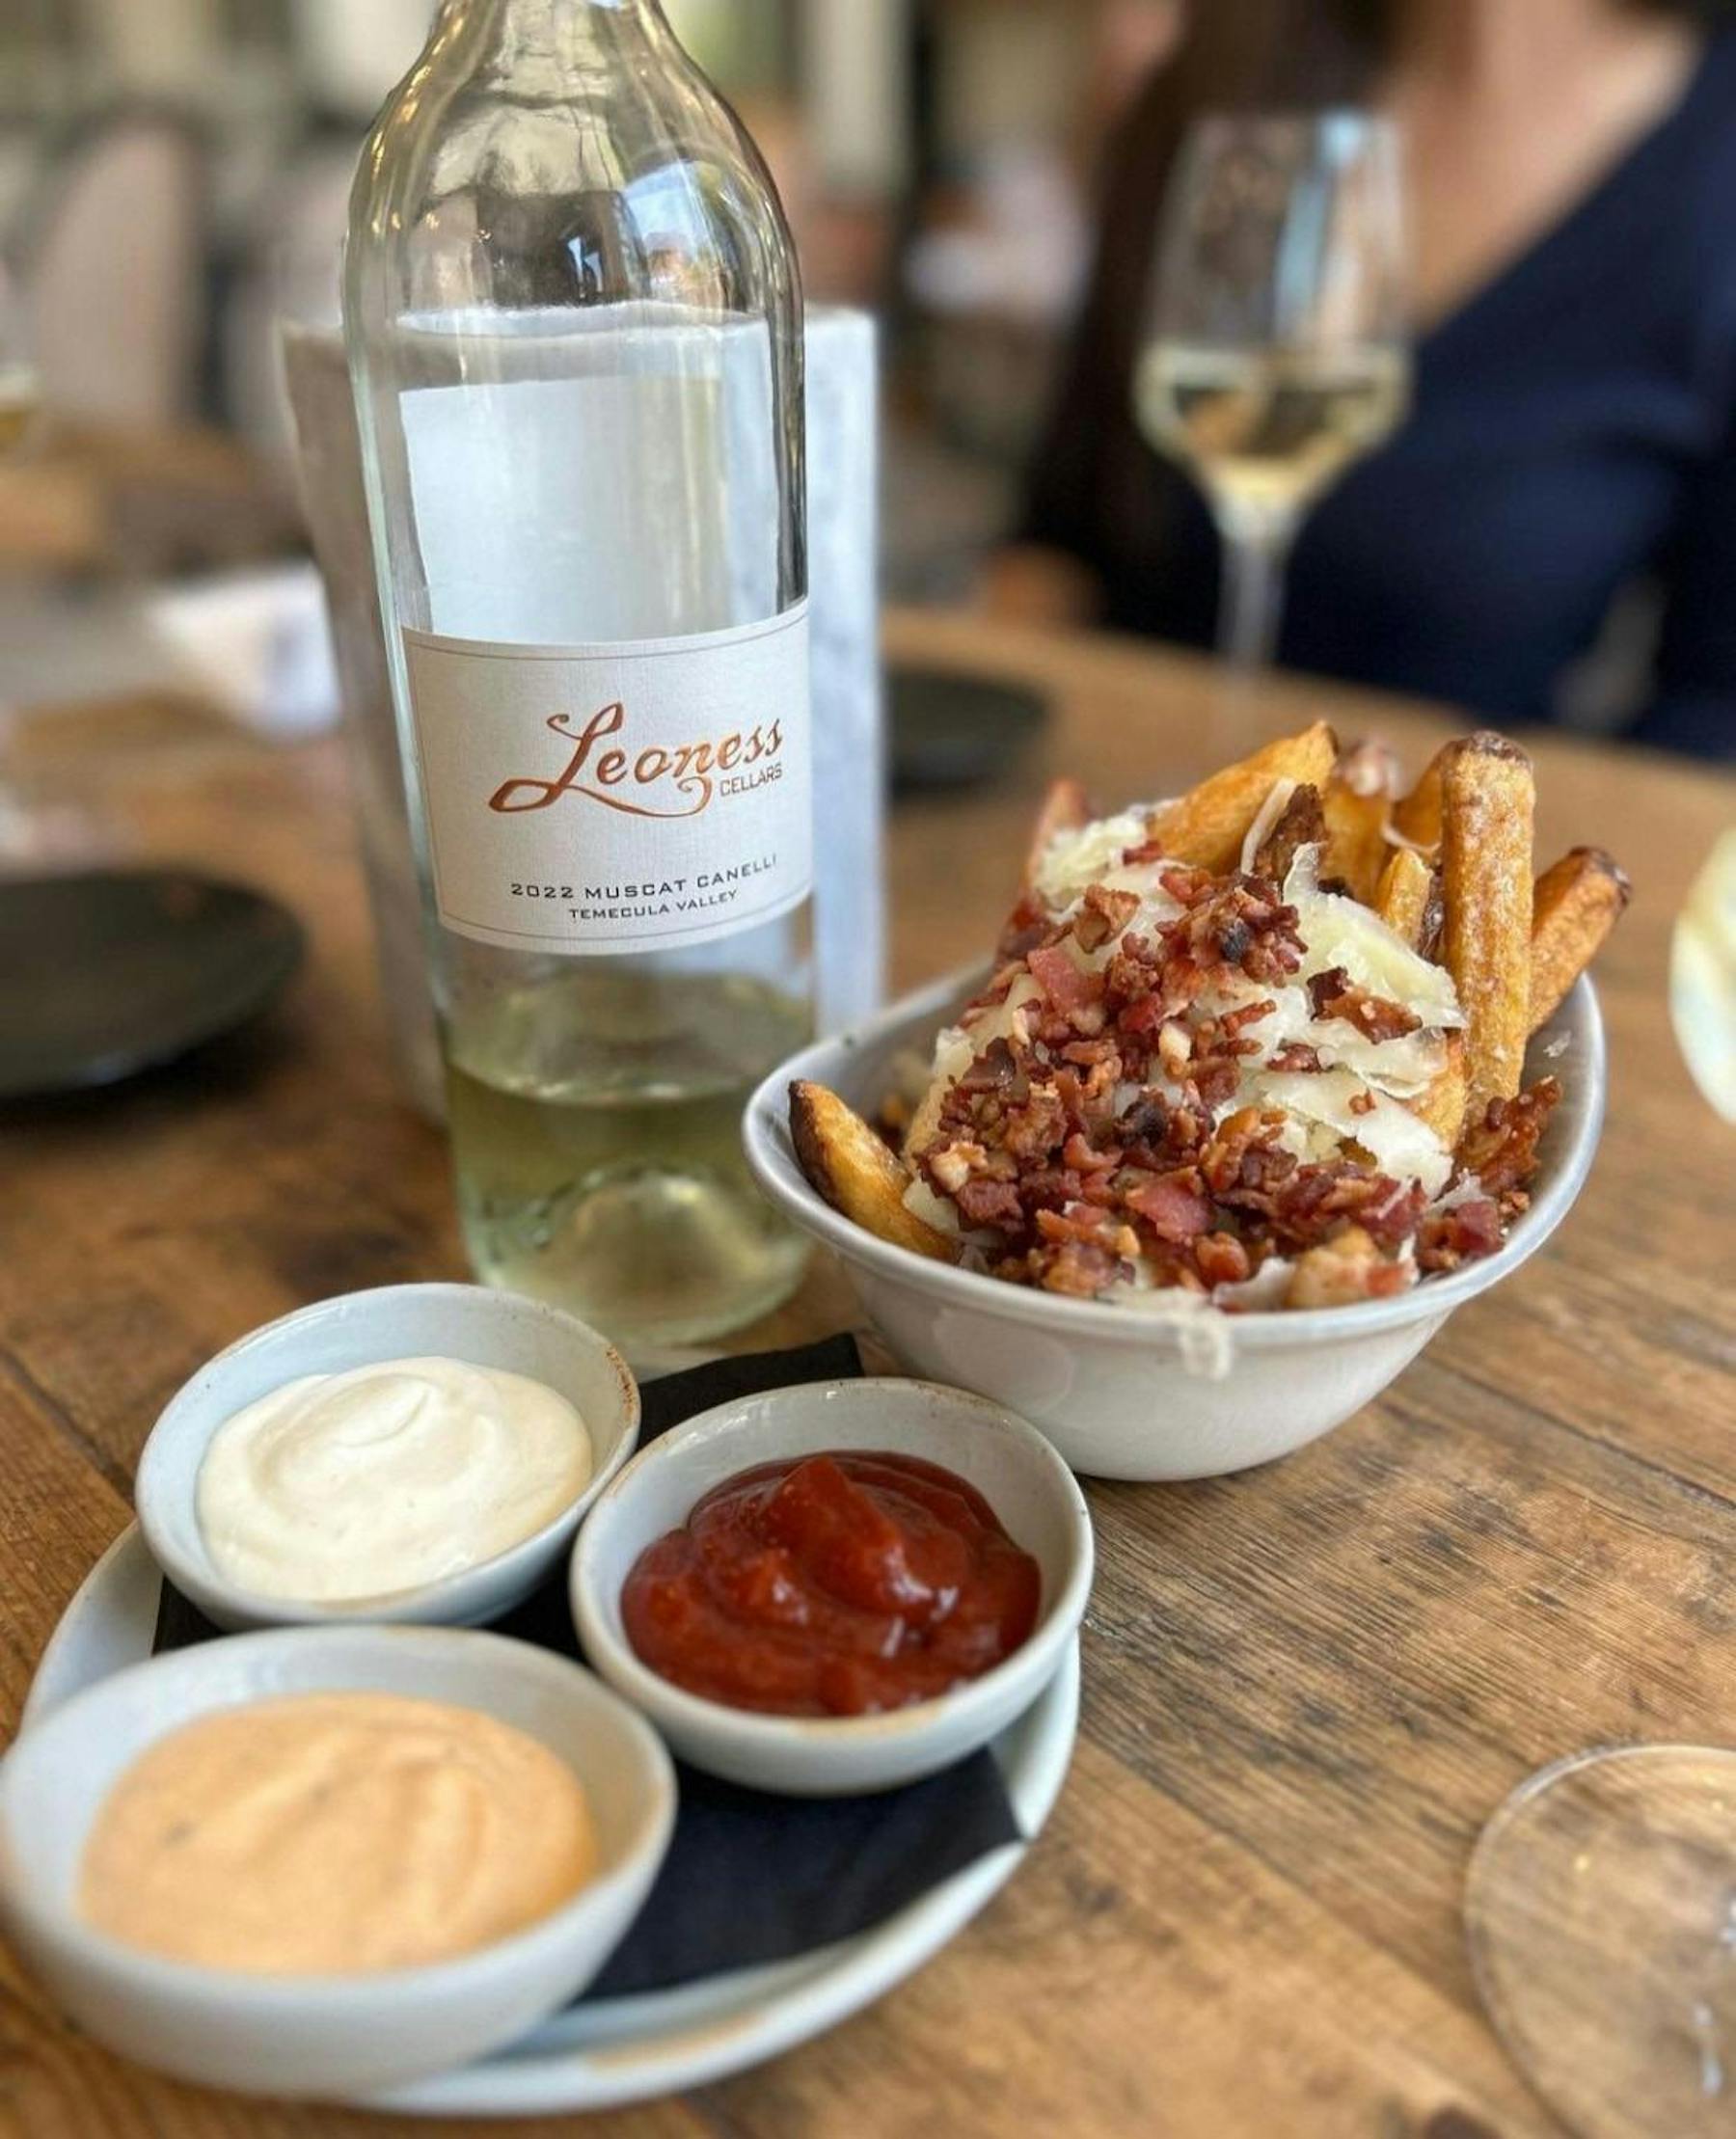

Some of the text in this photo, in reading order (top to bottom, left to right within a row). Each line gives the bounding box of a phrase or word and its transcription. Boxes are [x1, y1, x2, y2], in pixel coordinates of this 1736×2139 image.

[489, 701, 783, 818] Leoness
[719, 762, 783, 797] CELLARS
[510, 853, 777, 900] 2022 MUSCAT CANELLI
[568, 888, 738, 919] TEMECULA VALLEY
